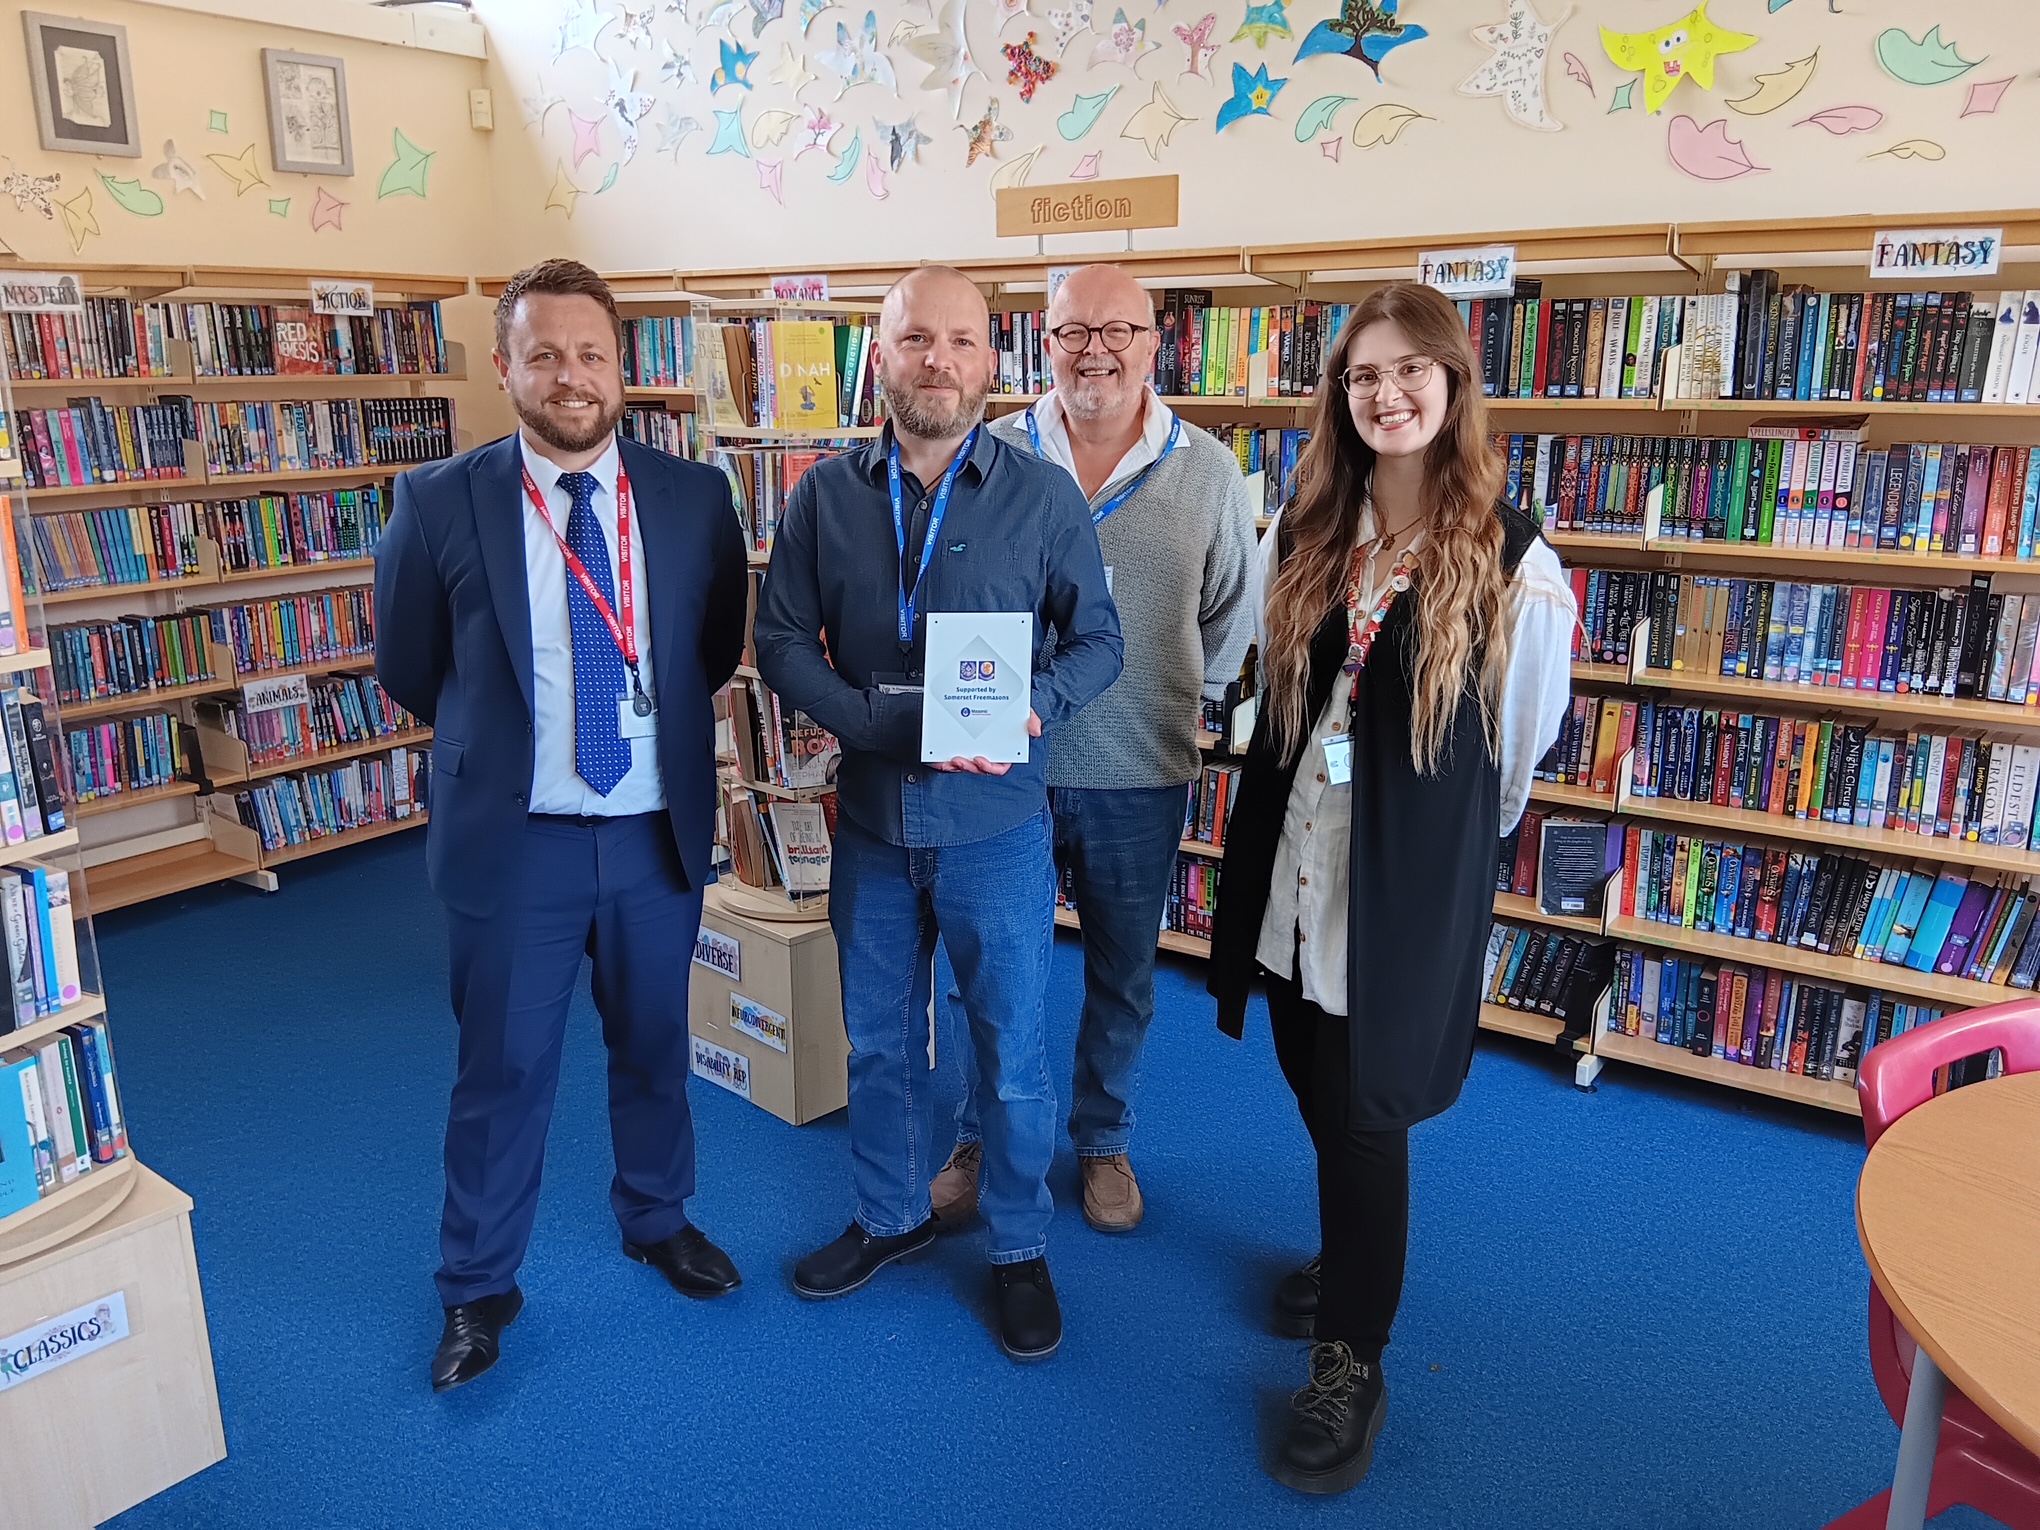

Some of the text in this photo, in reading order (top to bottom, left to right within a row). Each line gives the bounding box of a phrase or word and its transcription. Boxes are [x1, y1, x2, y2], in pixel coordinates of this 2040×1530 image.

[1031, 195, 1131, 224] fiction
[1876, 240, 1996, 268] FANTASY
[1421, 258, 1510, 284] FANTASY
[1, 285, 77, 305] MYSTERY
[321, 290, 367, 309] ACTION
[1592, 311, 1602, 332] KING
[1612, 312, 1622, 330] RULE
[1829, 304, 1838, 334] MEDUSA
[1874, 303, 1882, 323] RAVEN
[276, 322, 308, 343] RED
[1572, 321, 1582, 354] CROOKED
[1642, 315, 1654, 359] CRUEL PRINCE
[1662, 317, 1670, 342] WICKED
[1686, 320, 1695, 344] STOLEN
[1766, 302, 1780, 356] SKIN SEA
[1905, 328, 1917, 344] DEAD
[278, 340, 320, 364] NEMESIS
[849, 337, 858, 368] GILDED
[1192, 321, 1202, 372] TEMPES
[1282, 334, 1290, 362] WORLD
[1589, 339, 1599, 365] SCARS
[1608, 339, 1619, 366] WOLVES
[1782, 318, 1794, 370] REBEL ANGELS
[2022, 334, 2030, 355] ROGUE
[780, 362, 831, 379] DINAH
[1484, 348, 1493, 377] STORM
[1919, 356, 1928, 372] ALLEY
[1936, 356, 1944, 372] Fools
[1993, 364, 2002, 390] MISSION
[845, 370, 853, 393] ONES
[1170, 424, 1178, 442] VISITOR
[1750, 428, 1796, 438] SPELLSLINGER
[956, 438, 973, 461] VISITOR
[1782, 442, 1796, 484] SHADOWBLACK
[1810, 442, 1822, 484] SOULBINDER
[1822, 442, 1838, 482] QUEENSLAYER
[1838, 444, 1854, 490] CROWNBREAKER
[938, 472, 952, 500] VISITOR
[1666, 475, 1676, 514] DRAGON
[1680, 476, 1690, 515] DRAGON
[1696, 477, 1706, 516] DRAGON
[1714, 478, 1726, 517] DRAGON
[1764, 484, 1773, 502] HEART
[1884, 468, 1904, 524] LEGENDBORN
[2010, 454, 2026, 526] STORM KEEPER'S ISLAND
[1951, 494, 1960, 514] Eaters
[926, 516, 940, 546] VISITOR
[580, 572, 600, 600] VISITOR
[606, 612, 624, 641] VISITOR
[1755, 589, 1768, 643] SONG HUNTRESS
[1618, 628, 1630, 641] TREE
[1724, 620, 1736, 654] CURSES
[1742, 627, 1750, 642] JULIE
[255, 686, 300, 706] ANIMALS
[791, 736, 837, 758] BOY
[1668, 728, 1678, 762] SUMMONER
[1684, 728, 1694, 762] SUMMONER
[1704, 732, 1714, 766] SUMMONER
[1722, 733, 1732, 768] SUMMONER
[1736, 730, 1748, 762] MORTLOCK
[1753, 720, 1766, 754] HEDGEWITCH
[1778, 721, 1792, 756] WOODWITCH
[1904, 755, 1916, 783] THE FALL
[1916, 756, 1924, 776] AENIR
[1930, 742, 1942, 776] SABRIEL
[1842, 744, 1860, 808] Night Circus
[1941, 766, 1956, 805] ABHORSEN
[1983, 758, 2002, 820] ERAGON
[2007, 764, 2026, 820] ELDEST
[787, 844, 828, 855] brilliant
[788, 855, 830, 866] teenager
[1704, 856, 1716, 888] OLYMPUS
[1726, 859, 1738, 890] OLYMPUS
[1767, 864, 1780, 896] OLYMPUS
[1808, 872, 1832, 928] SORCERY THORNS
[1832, 878, 1846, 912] ENCHANTMENT
[1844, 882, 1858, 916] ENCHANTMENT
[1860, 890, 1873, 910] HARRY
[10, 913, 23, 938] Green
[12, 938, 26, 964] Gables
[694, 940, 735, 973] DIVERSE
[1808, 1020, 1821, 1062] STAR DANCER
[695, 1051, 747, 1084] DISABILITY REP
[13, 1317, 101, 1370] CLASSICS
